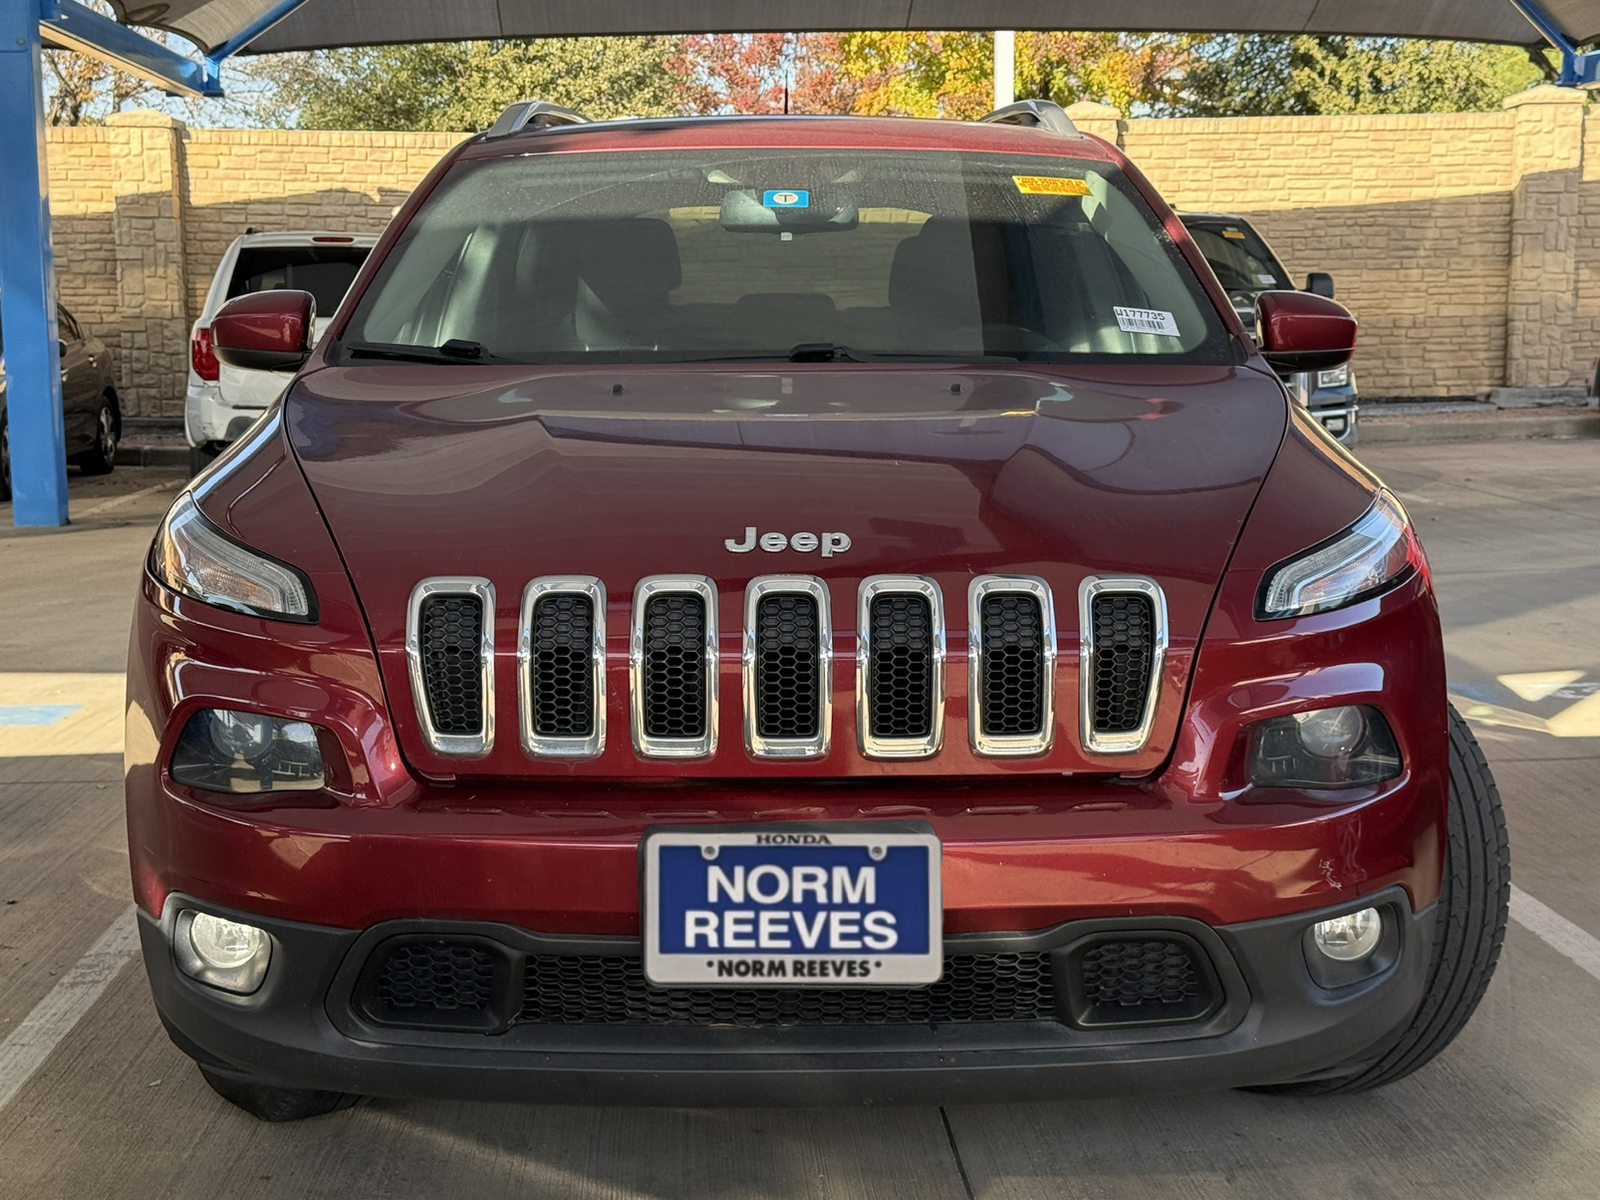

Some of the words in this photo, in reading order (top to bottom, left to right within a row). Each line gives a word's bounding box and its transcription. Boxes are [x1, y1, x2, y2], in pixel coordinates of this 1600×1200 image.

[724, 526, 852, 558] Jeep
[756, 834, 832, 845] HONDA
[707, 864, 876, 904] NORM
[684, 910, 899, 950] REEVES
[717, 959, 787, 978] NORM
[792, 959, 871, 978] REEVES
